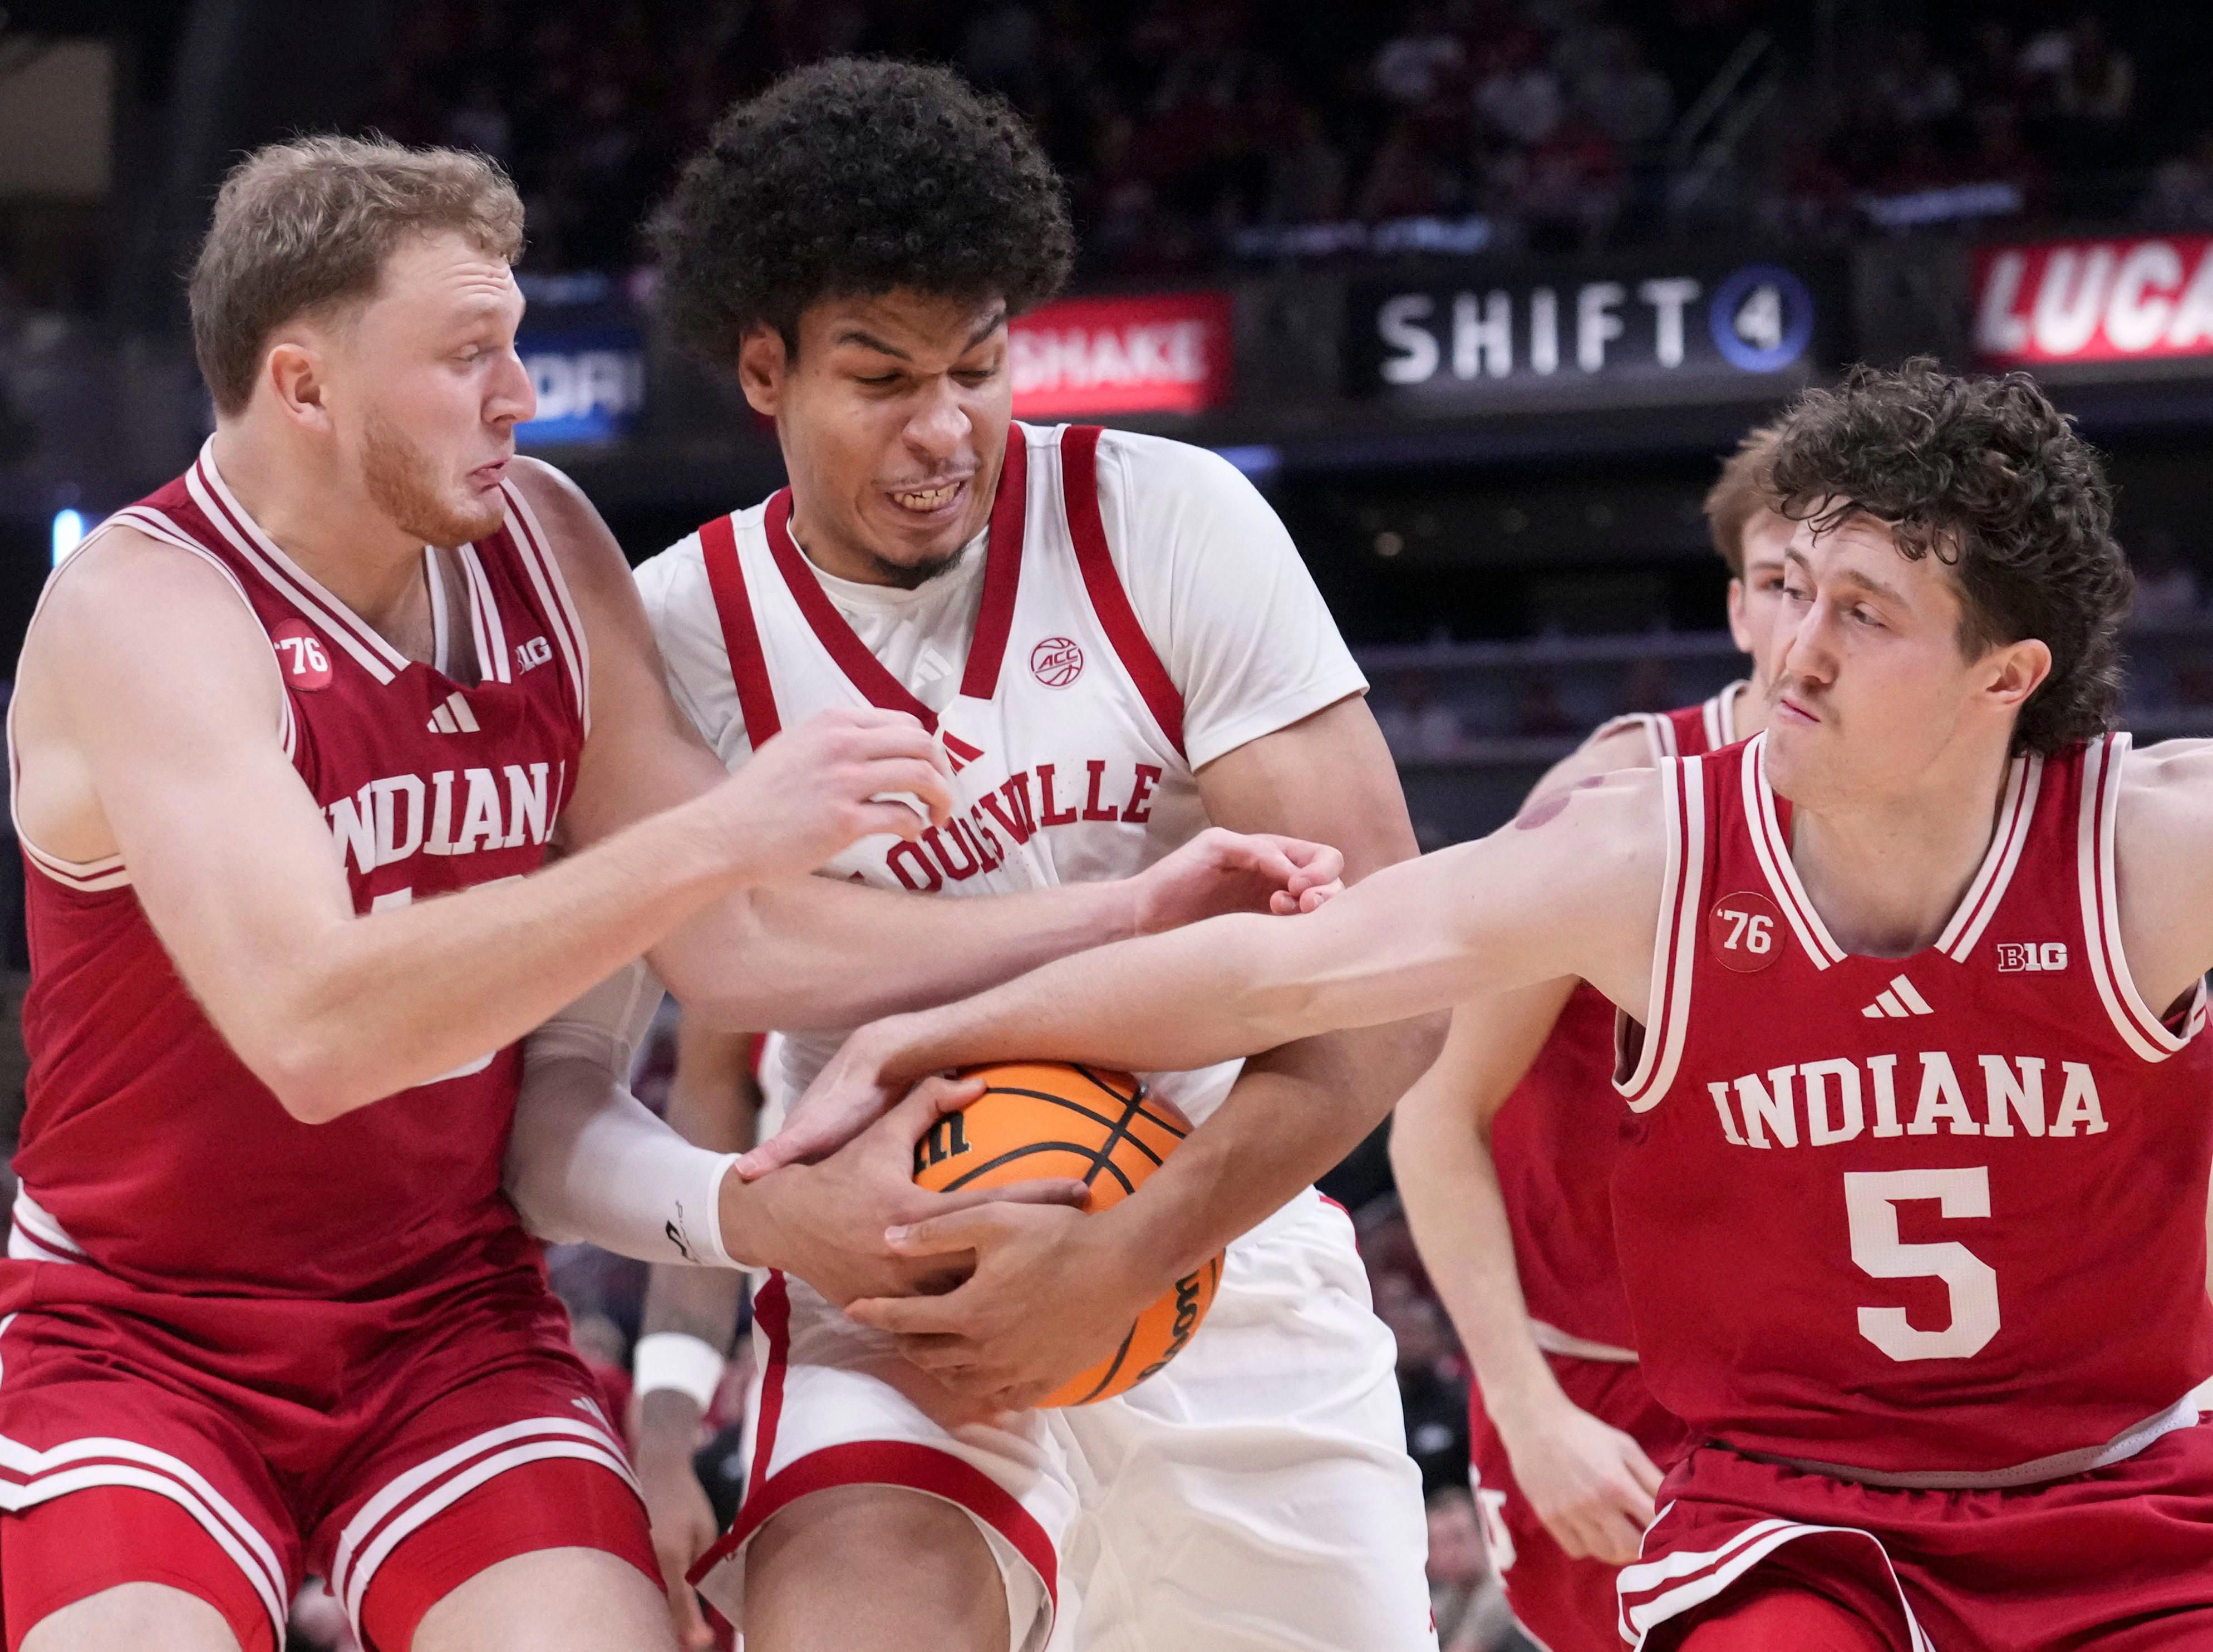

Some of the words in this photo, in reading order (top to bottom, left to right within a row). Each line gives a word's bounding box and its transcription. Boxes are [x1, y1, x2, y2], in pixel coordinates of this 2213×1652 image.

[319, 759, 565, 875] NDIAN
[848, 759, 1163, 892] OUISVILLE
[1707, 1051, 2109, 1149] INDIANA
[1843, 1166, 2001, 1362] 5
